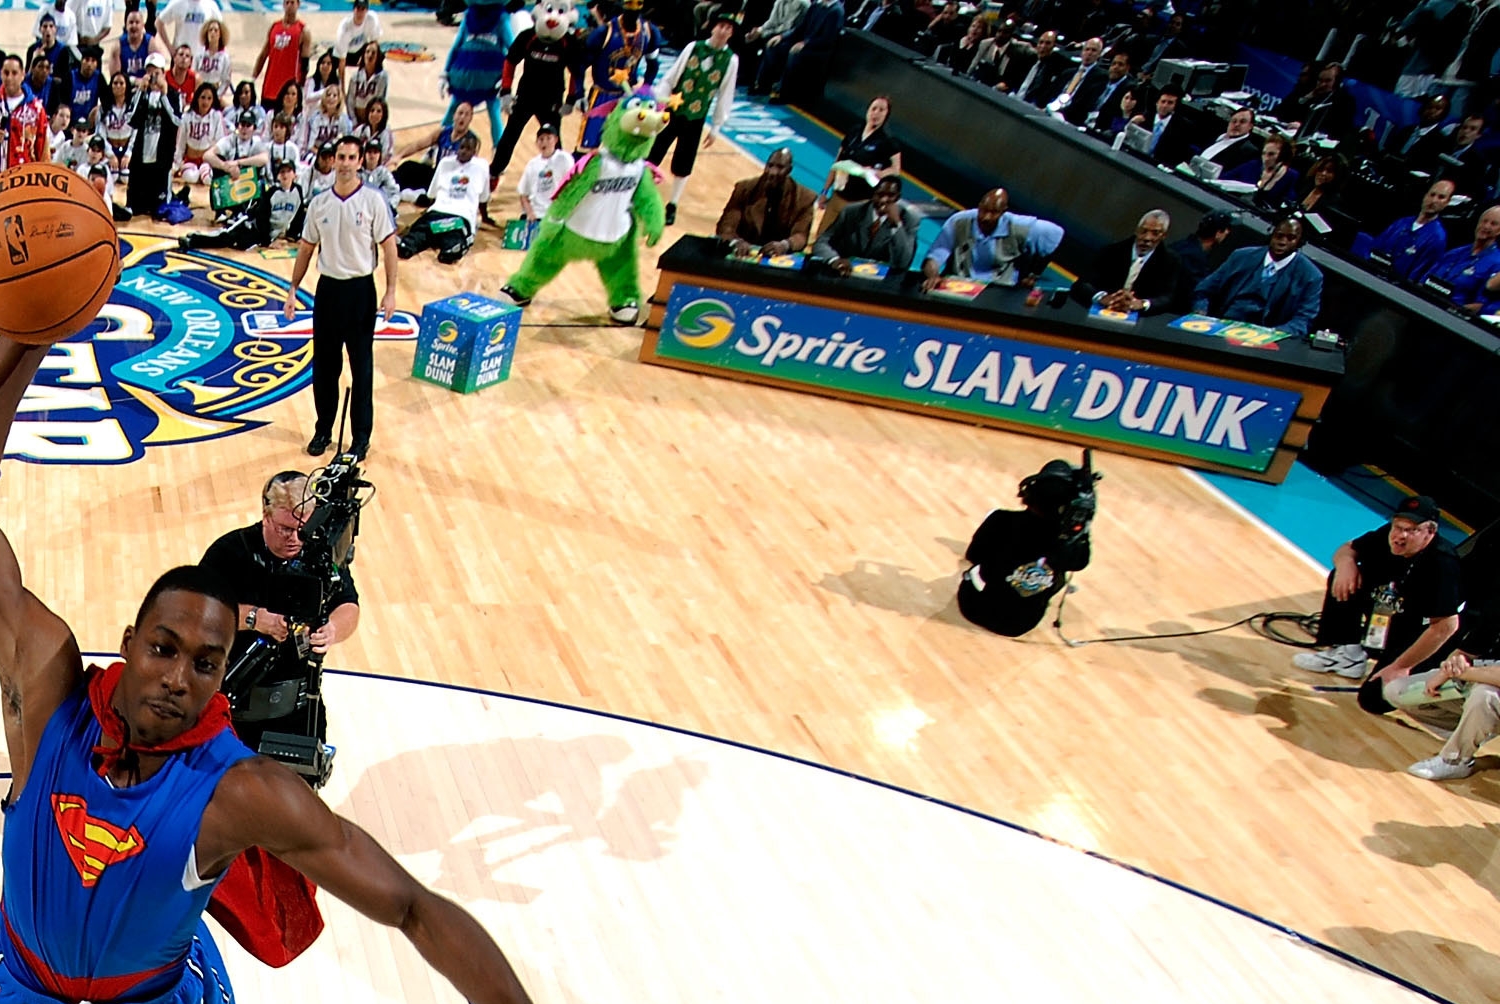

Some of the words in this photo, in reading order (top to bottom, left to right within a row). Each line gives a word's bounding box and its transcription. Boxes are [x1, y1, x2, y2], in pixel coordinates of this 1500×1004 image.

[121, 276, 202, 306] NEW
[130, 309, 220, 377] ORLEANS
[428, 352, 456, 373] SLAM
[480, 355, 503, 374] SLAM
[424, 365, 454, 385] DUNK
[475, 369, 500, 387] DUNK
[735, 315, 887, 374] Sprite
[903, 339, 1068, 413] SLAM
[1072, 369, 1268, 451] DUNK
